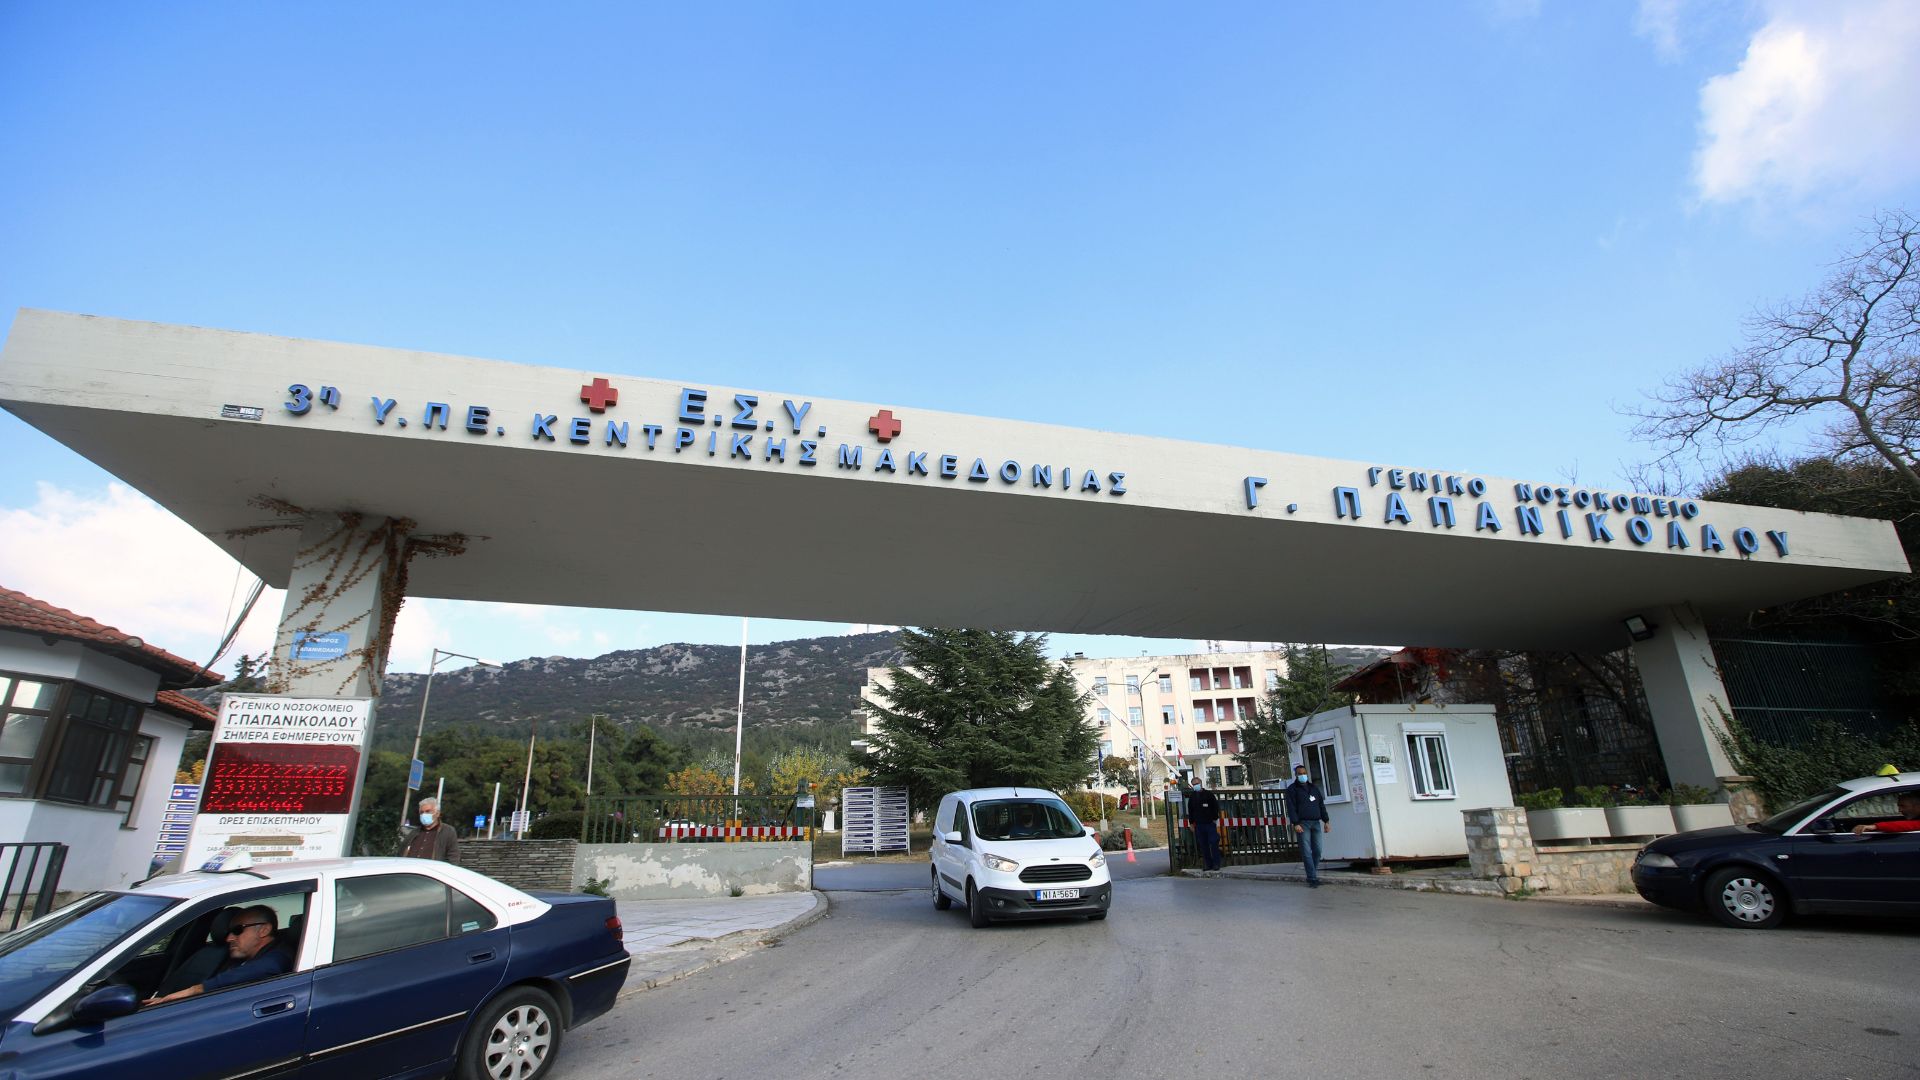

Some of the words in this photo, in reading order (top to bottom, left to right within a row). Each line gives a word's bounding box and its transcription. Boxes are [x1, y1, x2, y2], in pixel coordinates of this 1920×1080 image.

[679, 387, 827, 437] Ε.Σ.Υ.
[284, 383, 341, 415] 3η
[372, 396, 505, 436] Υ.ΠΕ.
[532, 413, 818, 467] ΚΕΝΤΡΙΚΗΣ
[839, 444, 1127, 496] ΜΑΚΕΔΟΝΙΑΣ
[1368, 466, 1487, 497] ΓΕΝΙΚΟ
[1514, 482, 1700, 520] ΝΟΣΟΚΟΜΕΙΟ
[1244, 476, 1297, 513] Γ.
[1333, 485, 1790, 560] ΠΑΠΑΝΙΚΟΛΑΟΥ
[227, 714, 358, 728] Γ.ΠΑΠΑΝΙΚΟΛΑΟΥ
[241, 701, 281, 711] ΓΕΝΙΚΟ
[283, 703, 354, 713] ΝΟΣΟΚΟΜΕΙΟ
[223, 730, 270, 741] ΣΗΜΕΡΑ
[272, 731, 355, 742] ΕΦΗΜΕΡΕΥΟΥΝ
[219, 816, 245, 825] ΩΡΕΣ
[246, 816, 322, 826] ΕΠΙΣΚΕΠΤΗΡΙΟΥ
